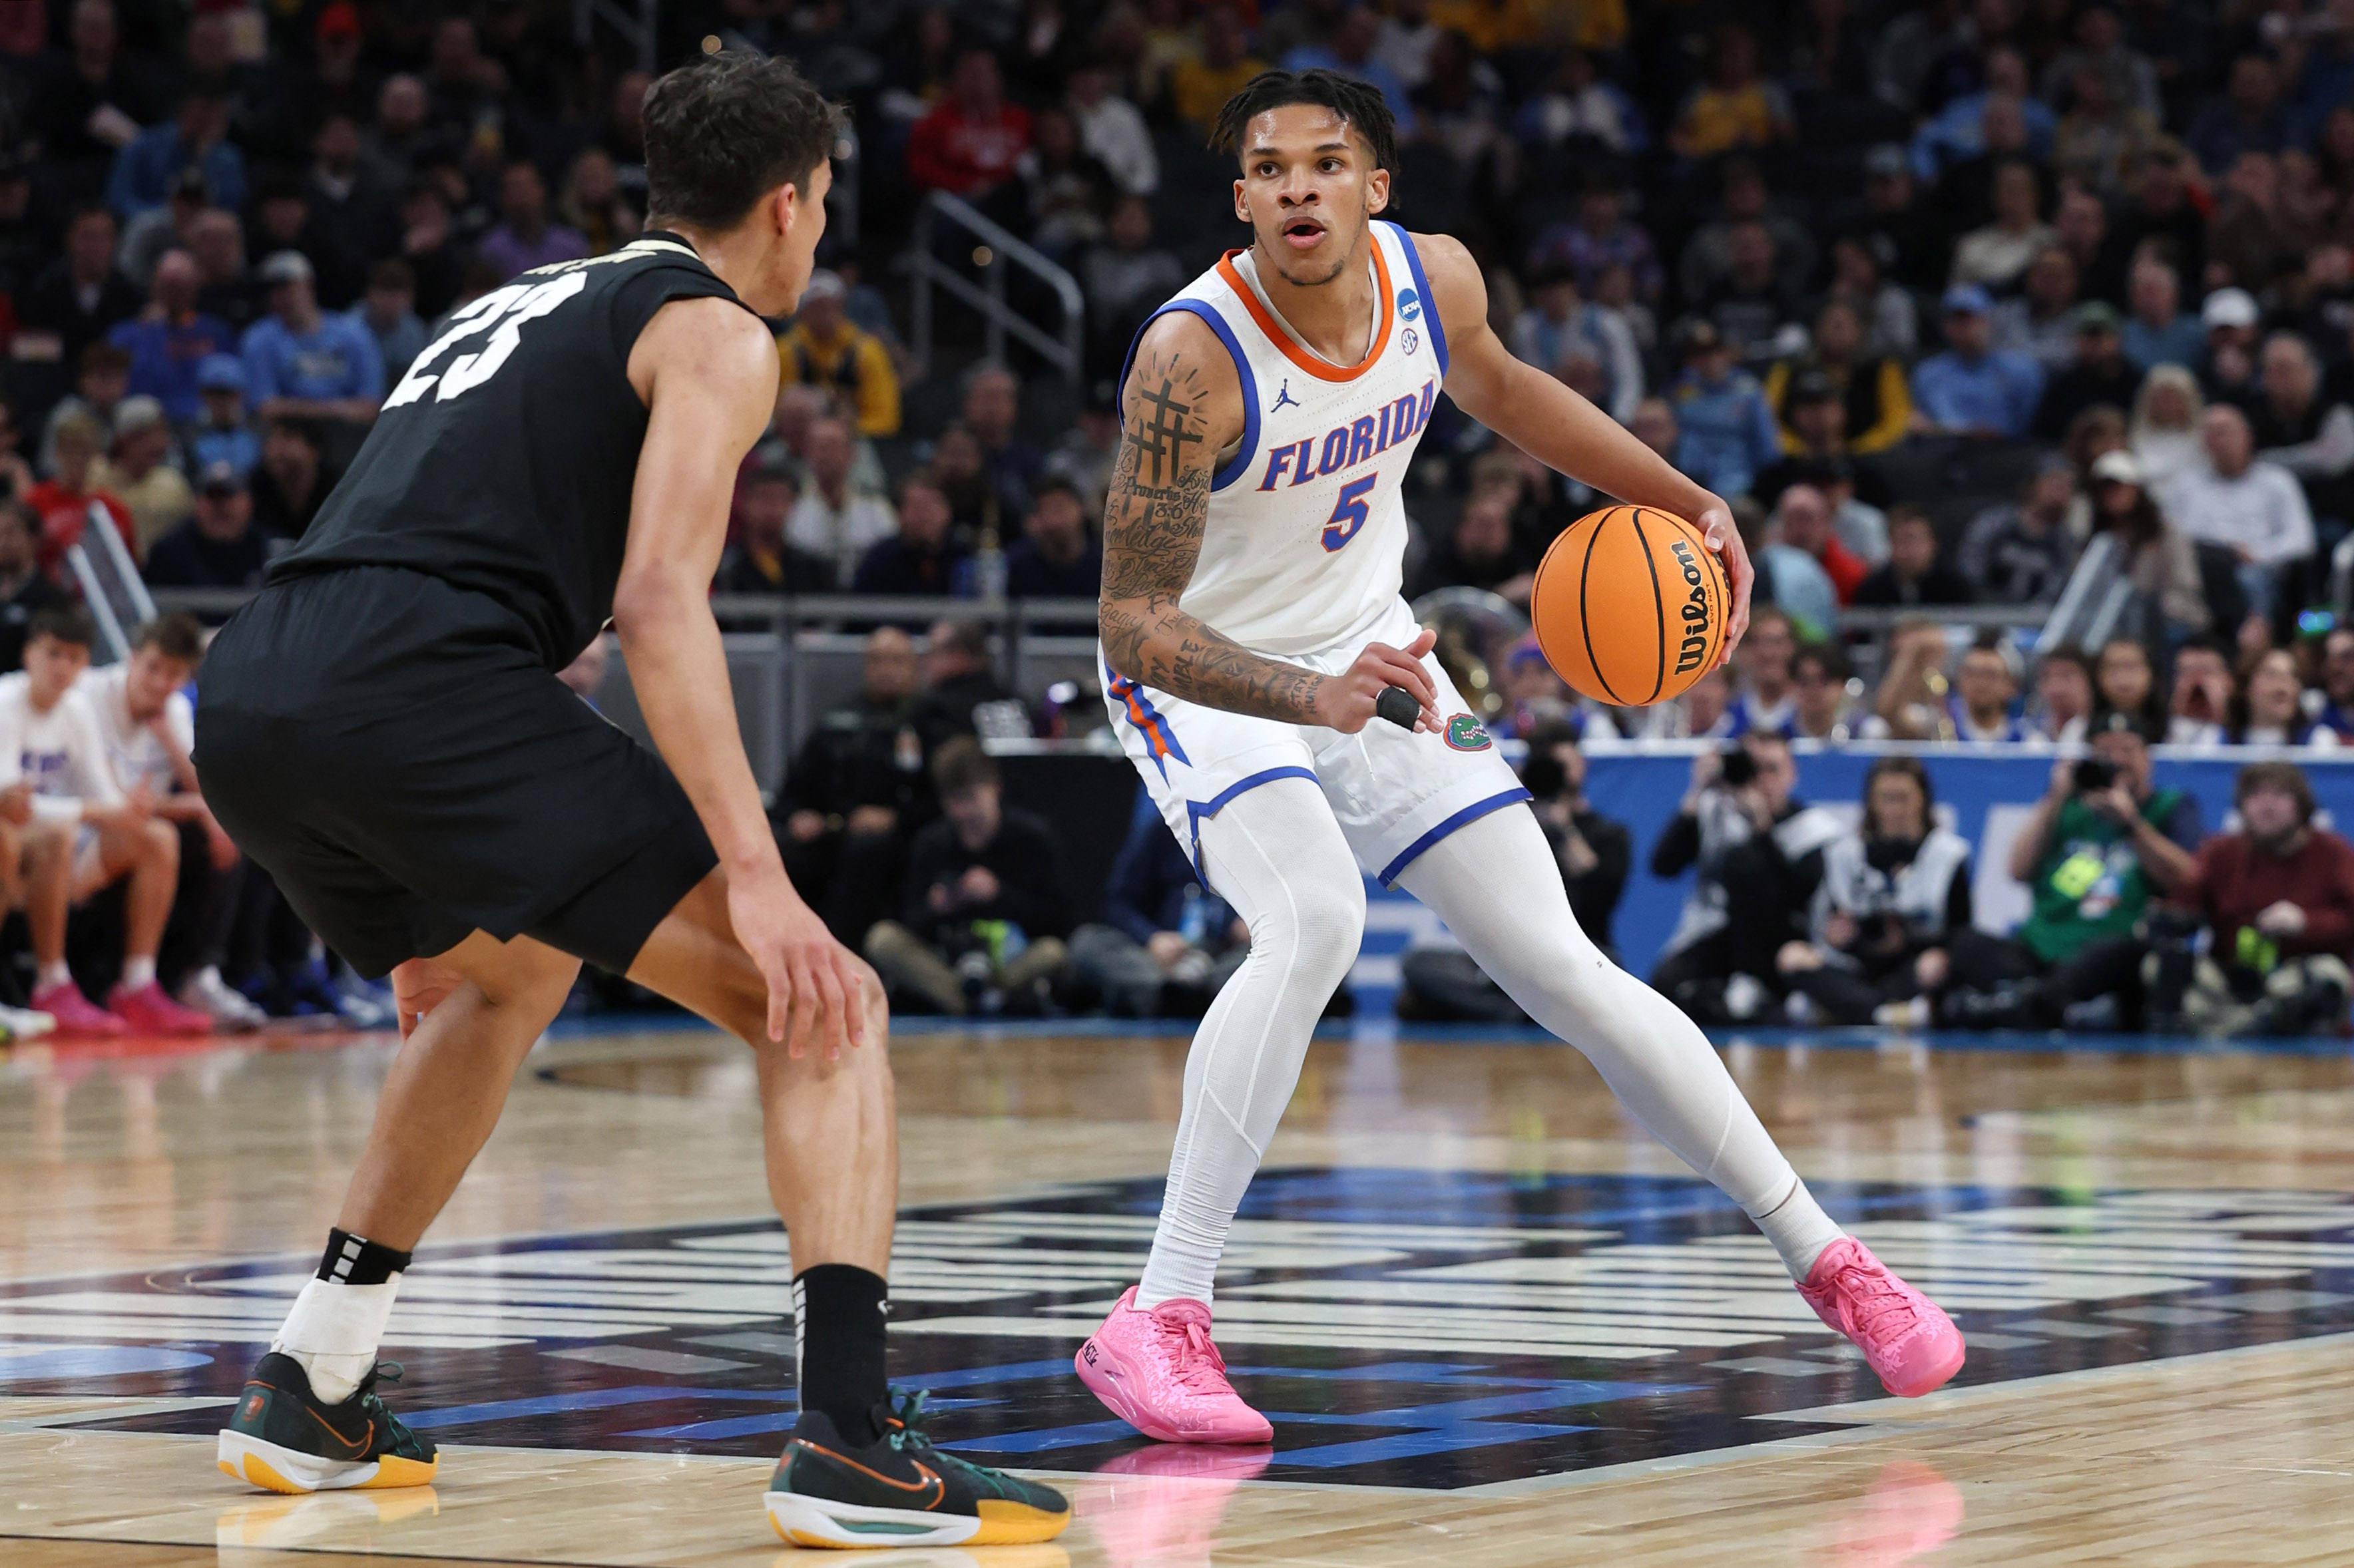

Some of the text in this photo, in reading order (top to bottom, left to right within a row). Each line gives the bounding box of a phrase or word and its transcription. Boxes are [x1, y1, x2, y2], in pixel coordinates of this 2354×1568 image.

[379, 271, 588, 412] 23
[1401, 299, 1421, 315] NCAA
[1401, 329, 1417, 354] SEC
[1255, 378, 1434, 491] FLORIDA
[1321, 471, 1379, 552] 5
[1670, 540, 1709, 676] Wilson
